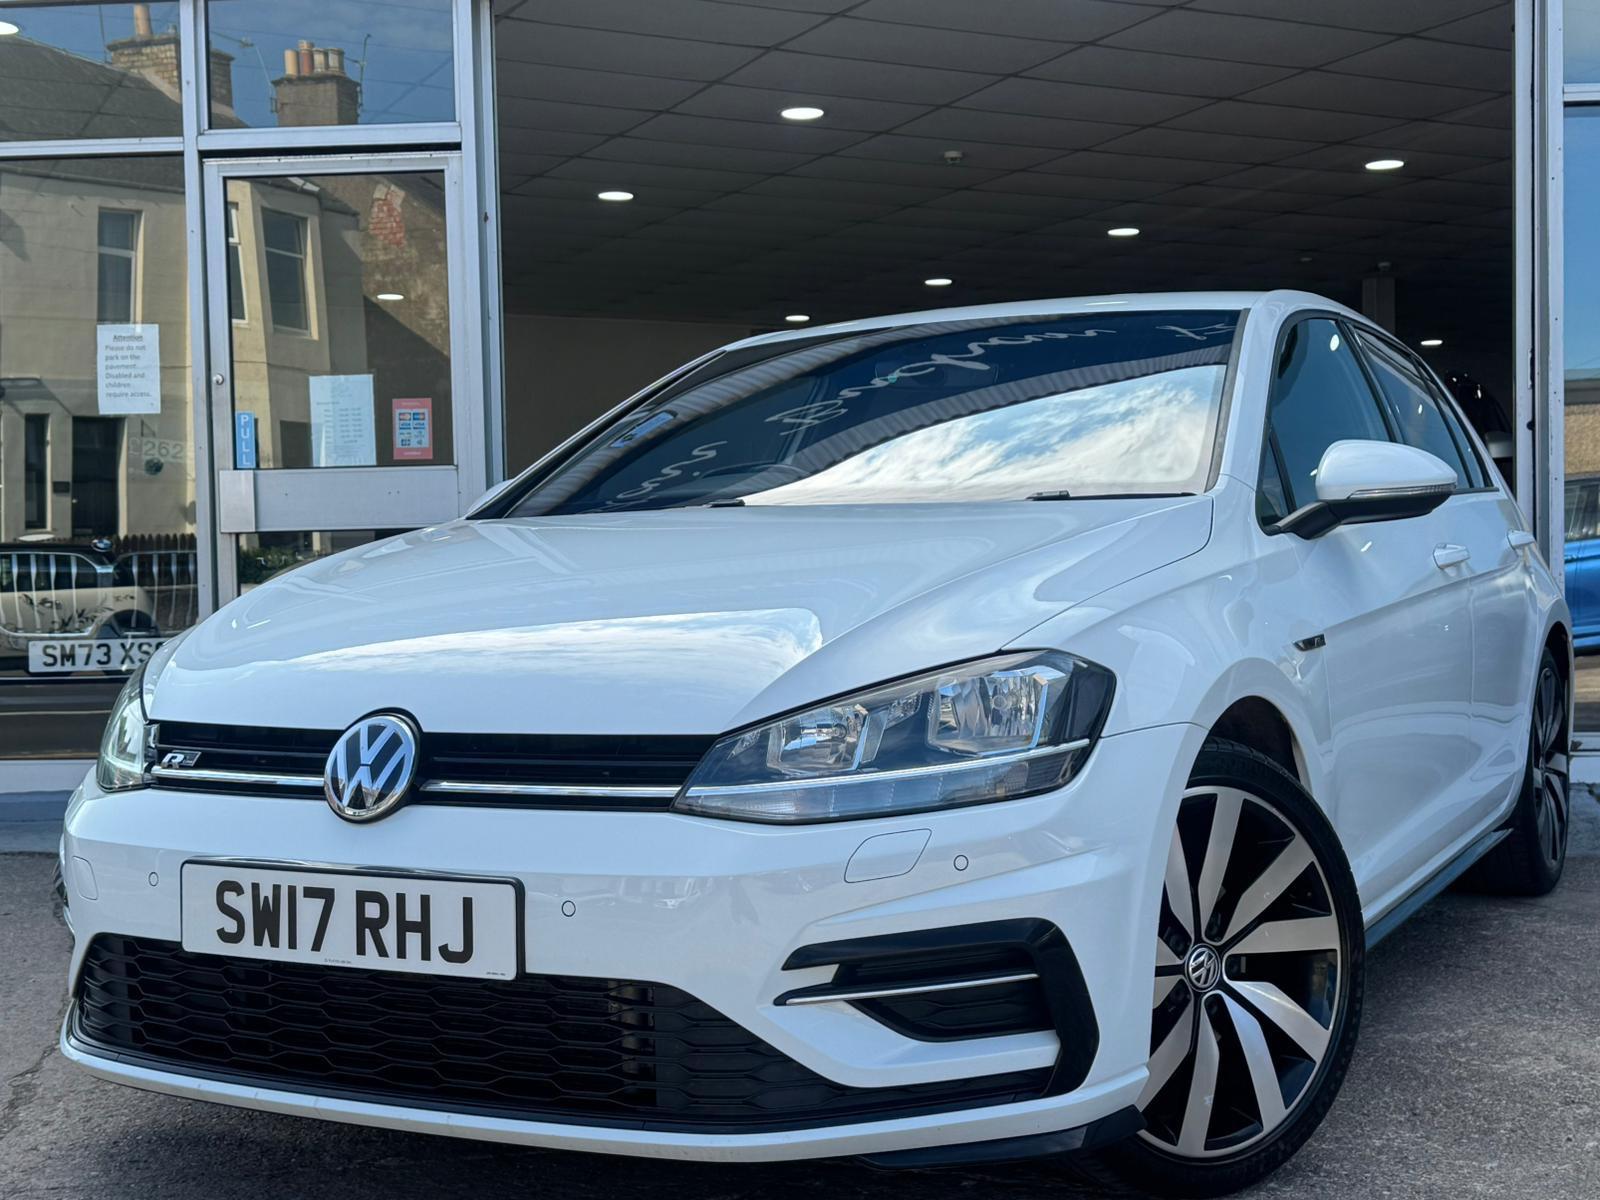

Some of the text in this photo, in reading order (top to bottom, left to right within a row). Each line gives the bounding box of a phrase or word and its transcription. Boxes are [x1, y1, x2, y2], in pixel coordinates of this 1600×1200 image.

[113, 334, 143, 342] Attention
[105, 354, 119, 362] park
[240, 415, 250, 465] PULL
[42, 643, 112, 667] SM73
[216, 879, 474, 964] SW17 RHJ
